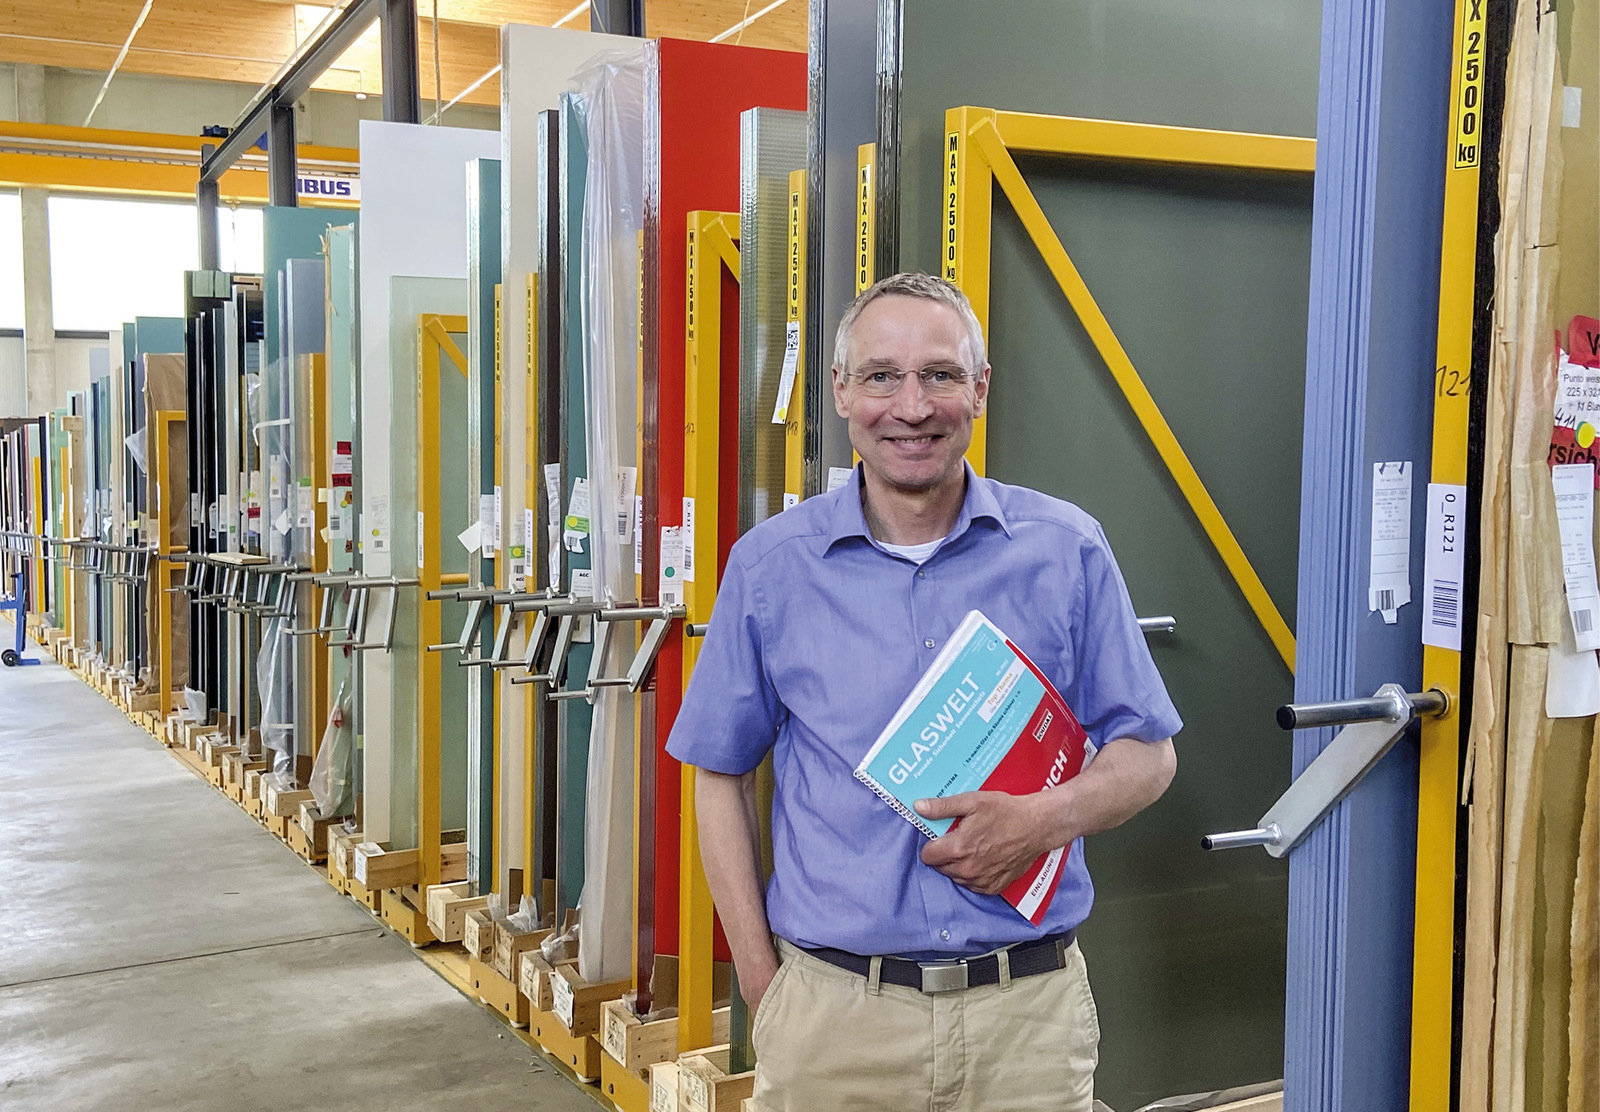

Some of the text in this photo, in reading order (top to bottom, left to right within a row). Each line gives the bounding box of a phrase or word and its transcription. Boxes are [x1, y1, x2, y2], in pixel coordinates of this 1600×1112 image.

[1462, 31, 1481, 135] 2500
[1457, 143, 1476, 163] kg
[298, 179, 351, 196] BUS
[946, 135, 958, 280] MAX 2500 kg
[1563, 373, 1584, 384] Punto
[1566, 387, 1581, 397] 225
[1583, 389, 1588, 397] x
[888, 671, 979, 785] GLASWELT
[932, 728, 957, 757] Sicherheit
[955, 690, 986, 729] Sonnenschutz
